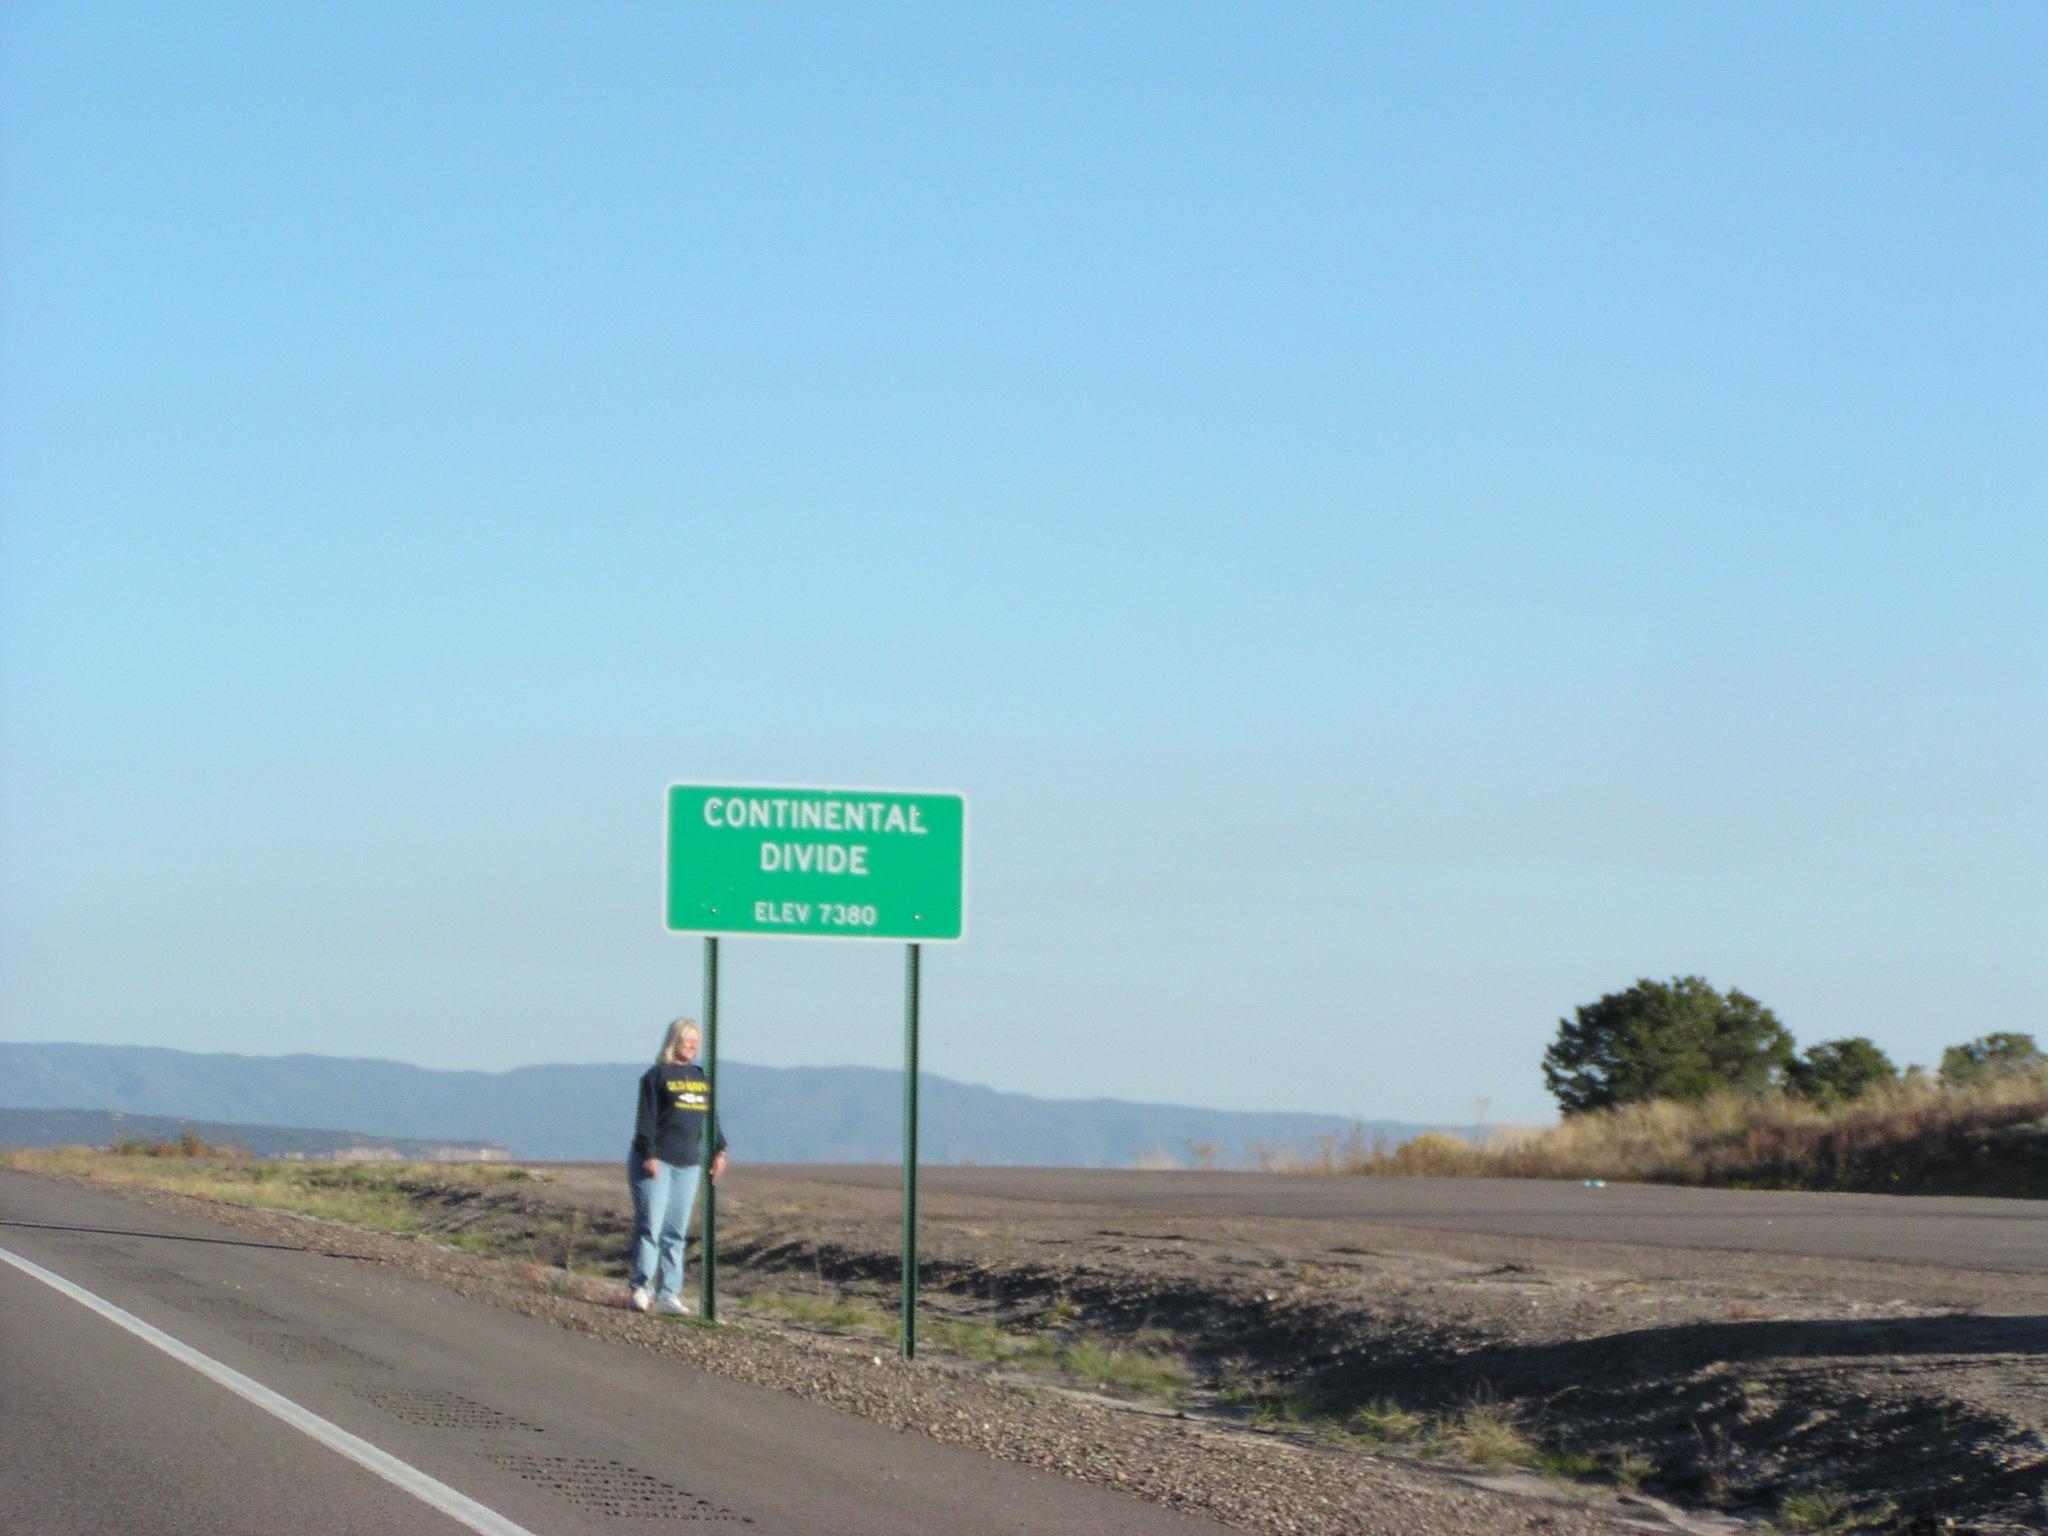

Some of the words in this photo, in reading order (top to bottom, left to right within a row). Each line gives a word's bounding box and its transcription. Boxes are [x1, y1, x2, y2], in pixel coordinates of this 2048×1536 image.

[704, 797, 927, 833] CONTINENTAL
[760, 842, 869, 875] DIVIDE
[754, 901, 810, 923] ELEV
[819, 904, 877, 926] 7380
